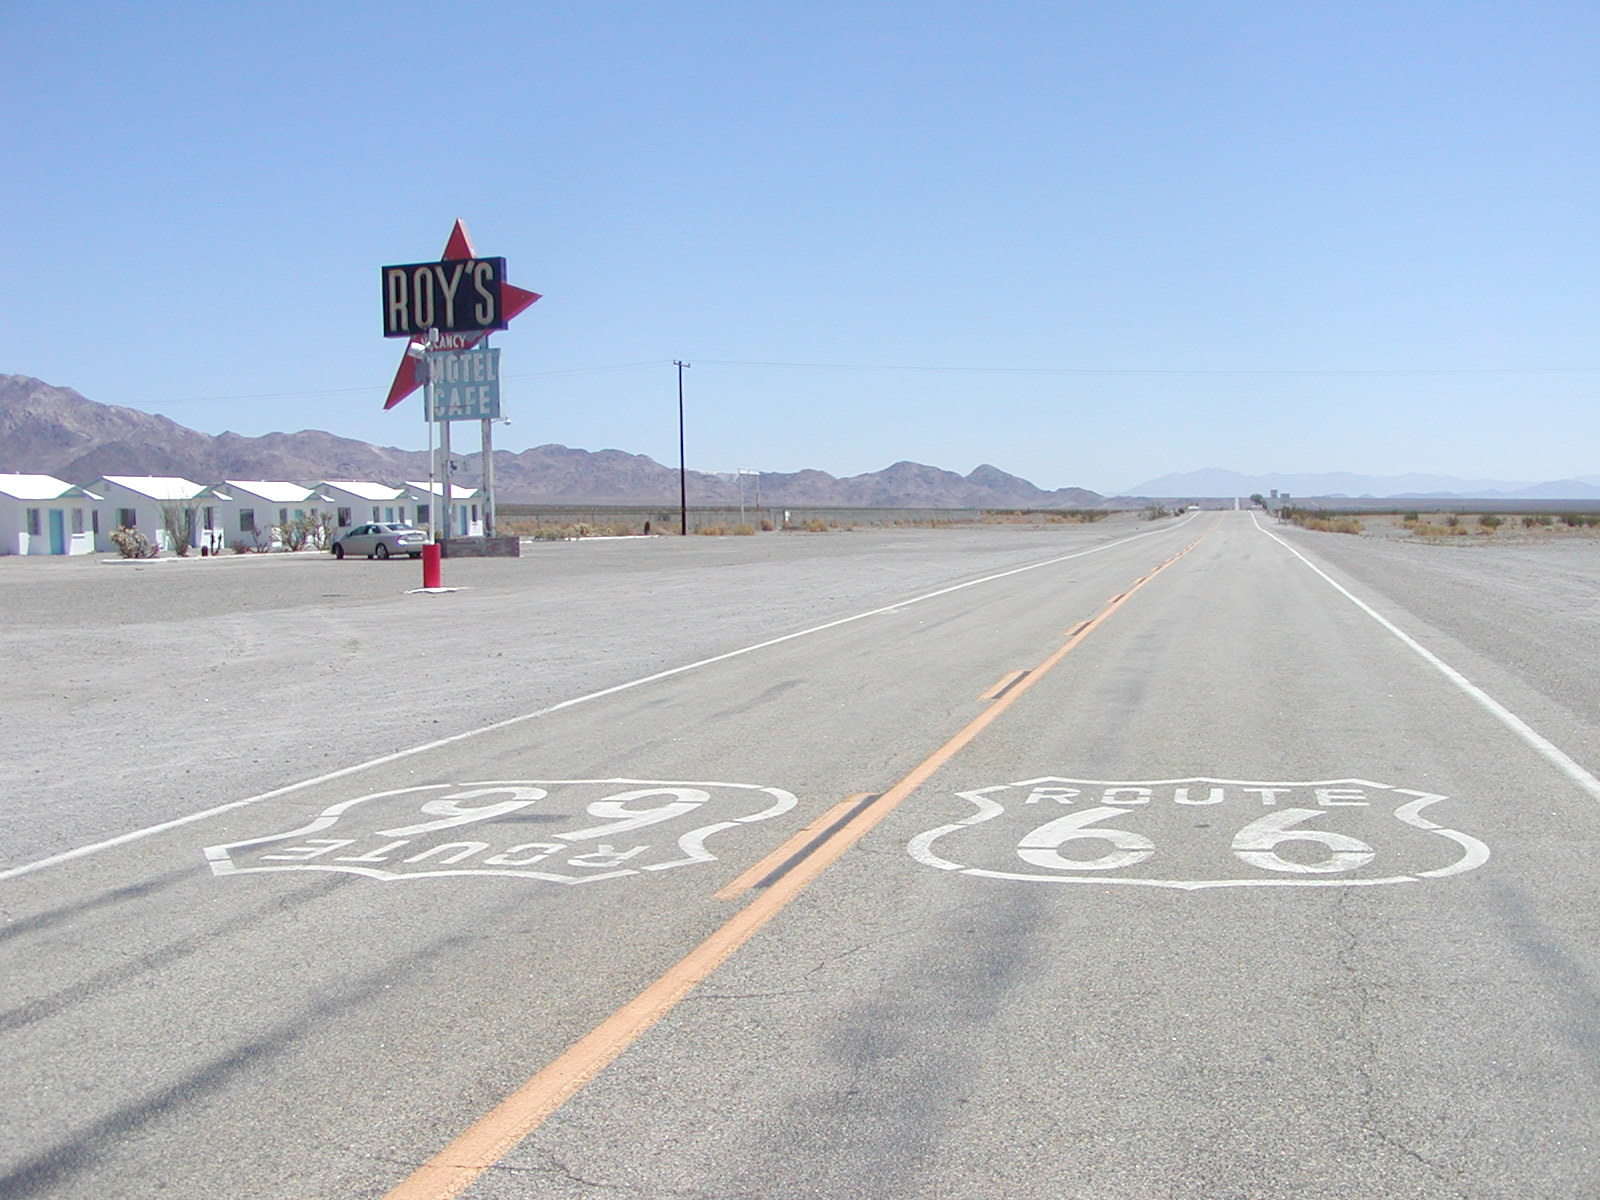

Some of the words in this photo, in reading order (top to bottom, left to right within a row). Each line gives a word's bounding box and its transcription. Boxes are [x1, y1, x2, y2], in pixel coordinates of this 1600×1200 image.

[388, 260, 495, 332] ROY'S
[430, 353, 496, 384] MOTEL
[434, 386, 491, 416] CAFE
[1025, 786, 1371, 807] ROUTE
[1016, 806, 1376, 873] 66
